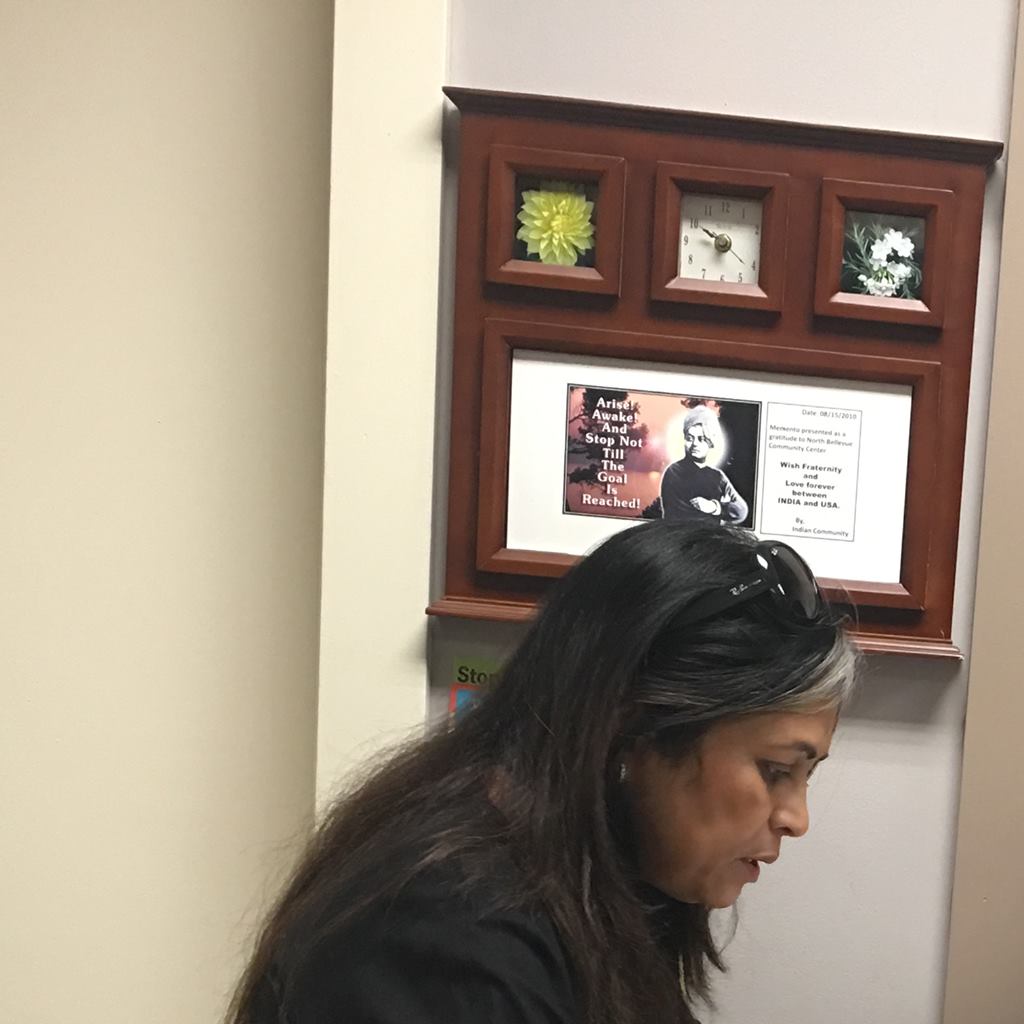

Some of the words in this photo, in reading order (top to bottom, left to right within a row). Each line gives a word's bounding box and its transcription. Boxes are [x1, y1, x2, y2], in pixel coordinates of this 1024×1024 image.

[690, 217, 699, 230] 10
[683, 234, 689, 246] 9
[688, 254, 694, 265] 8
[702, 268, 707, 279] 7
[596, 397, 634, 410] Arise!
[592, 408, 638, 423] Awake!
[602, 422, 628, 434] And
[769, 424, 800, 433] Memento
[801, 427, 832, 436] presented
[585, 432, 615, 448] Stop
[620, 435, 643, 448] Not
[826, 439, 853, 447] Bellevue
[769, 442, 804, 452] Community
[602, 447, 624, 460] Till
[601, 459, 625, 471] The
[780, 461, 800, 469] Wish
[802, 463, 842, 474] Fraternity
[597, 471, 628, 484] Goal
[607, 484, 618, 495] Is
[785, 480, 804, 488] Love
[806, 482, 835, 490] forever
[792, 490, 827, 498] between
[582, 493, 640, 509] Reached!
[778, 497, 801, 505] INDIA
[813, 528, 849, 537] Community
